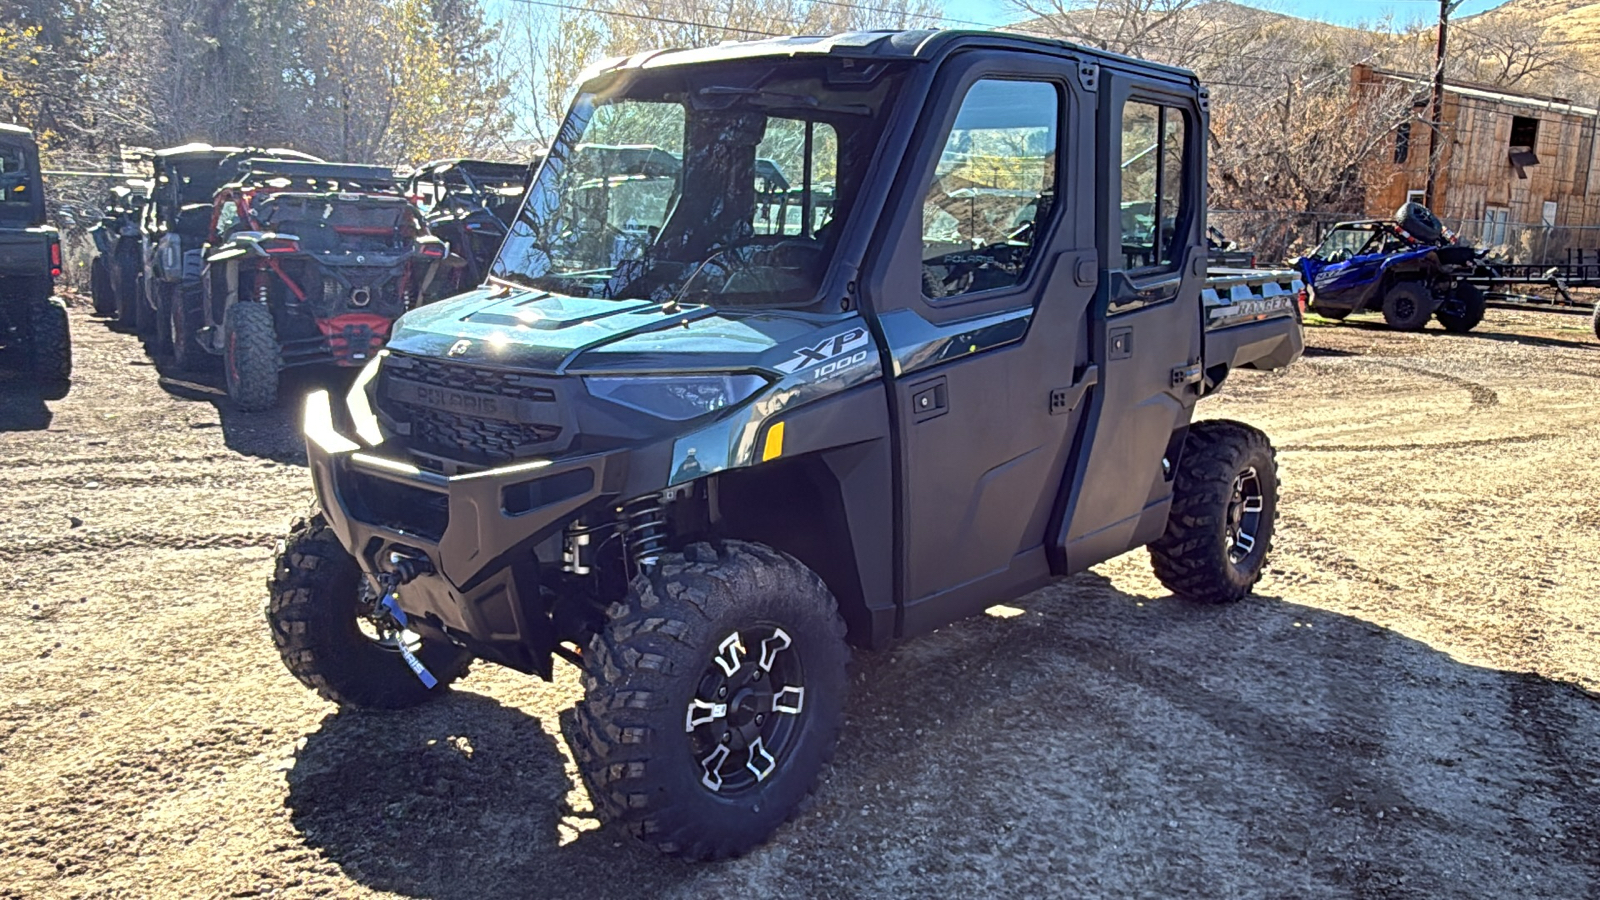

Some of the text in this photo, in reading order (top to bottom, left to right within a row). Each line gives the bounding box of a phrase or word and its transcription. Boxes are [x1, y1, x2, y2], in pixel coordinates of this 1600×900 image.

[944, 254, 995, 264] POLARIS
[1238, 296, 1289, 315] RANGER
[791, 327, 867, 372] XP
[814, 350, 868, 379] 1000
[417, 386, 498, 413] POLARIS
